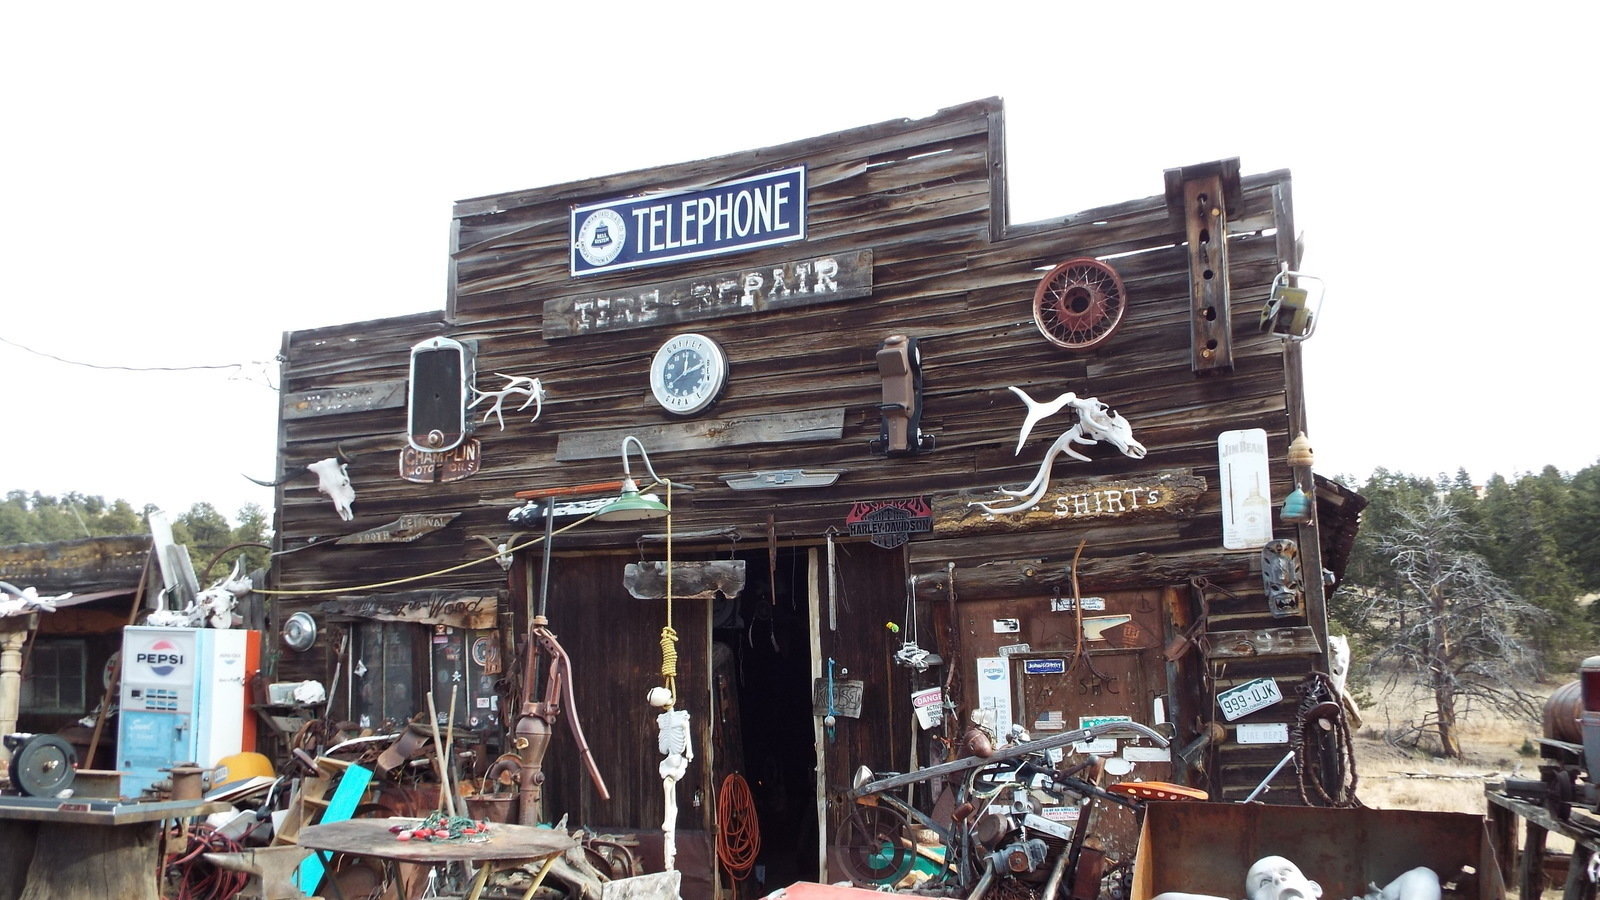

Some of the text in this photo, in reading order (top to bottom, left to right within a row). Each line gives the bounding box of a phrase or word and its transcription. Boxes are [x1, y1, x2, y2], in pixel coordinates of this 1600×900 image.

[632, 181, 790, 253] TELEPHONE
[691, 257, 839, 312] REPAIR
[405, 443, 476, 465] CHAMPLIN
[449, 462, 474, 472] OILS
[358, 531, 390, 542] TOOTH
[429, 593, 484, 618] Wood
[137, 653, 183, 664] PEPSI
[917, 693, 941, 705] DANGE
[1240, 700, 1268, 714] COLORADO
